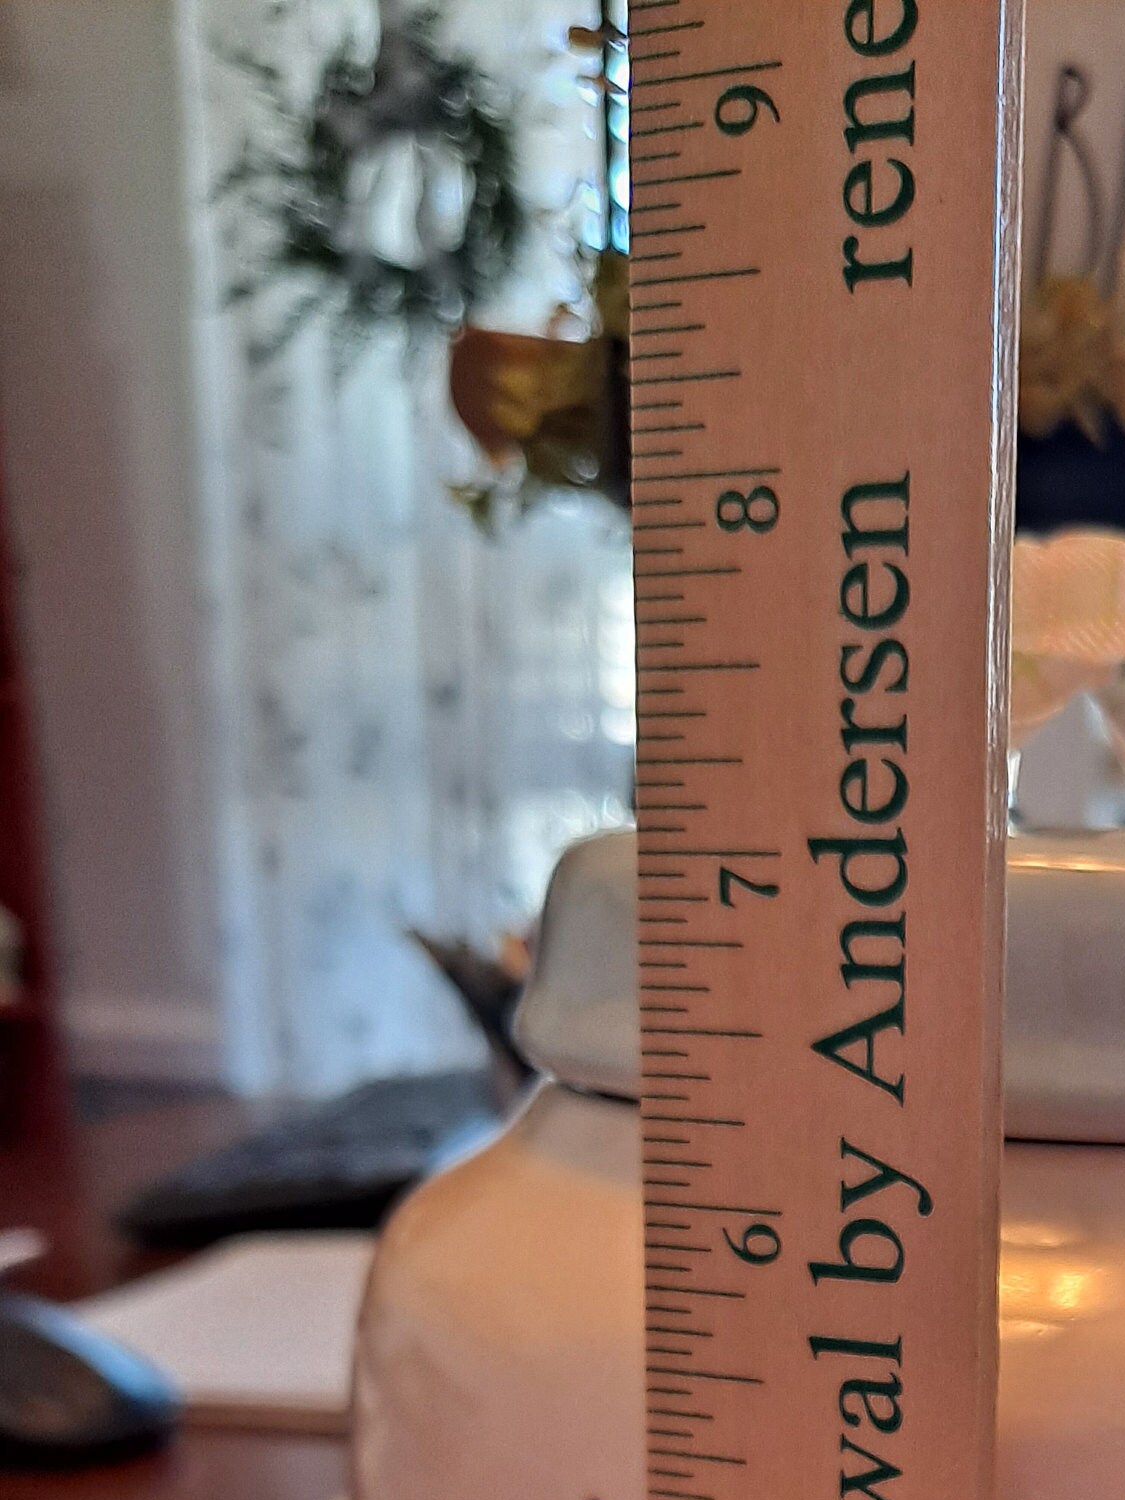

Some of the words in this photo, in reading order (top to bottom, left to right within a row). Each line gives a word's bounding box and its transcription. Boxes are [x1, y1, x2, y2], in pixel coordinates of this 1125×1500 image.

[714, 85, 780, 136] 9
[716, 485, 780, 533] 8
[807, 470, 910, 1107] Andersen
[719, 866, 780, 908] 7
[807, 1137, 933, 1286] by
[722, 1224, 781, 1265] 6
